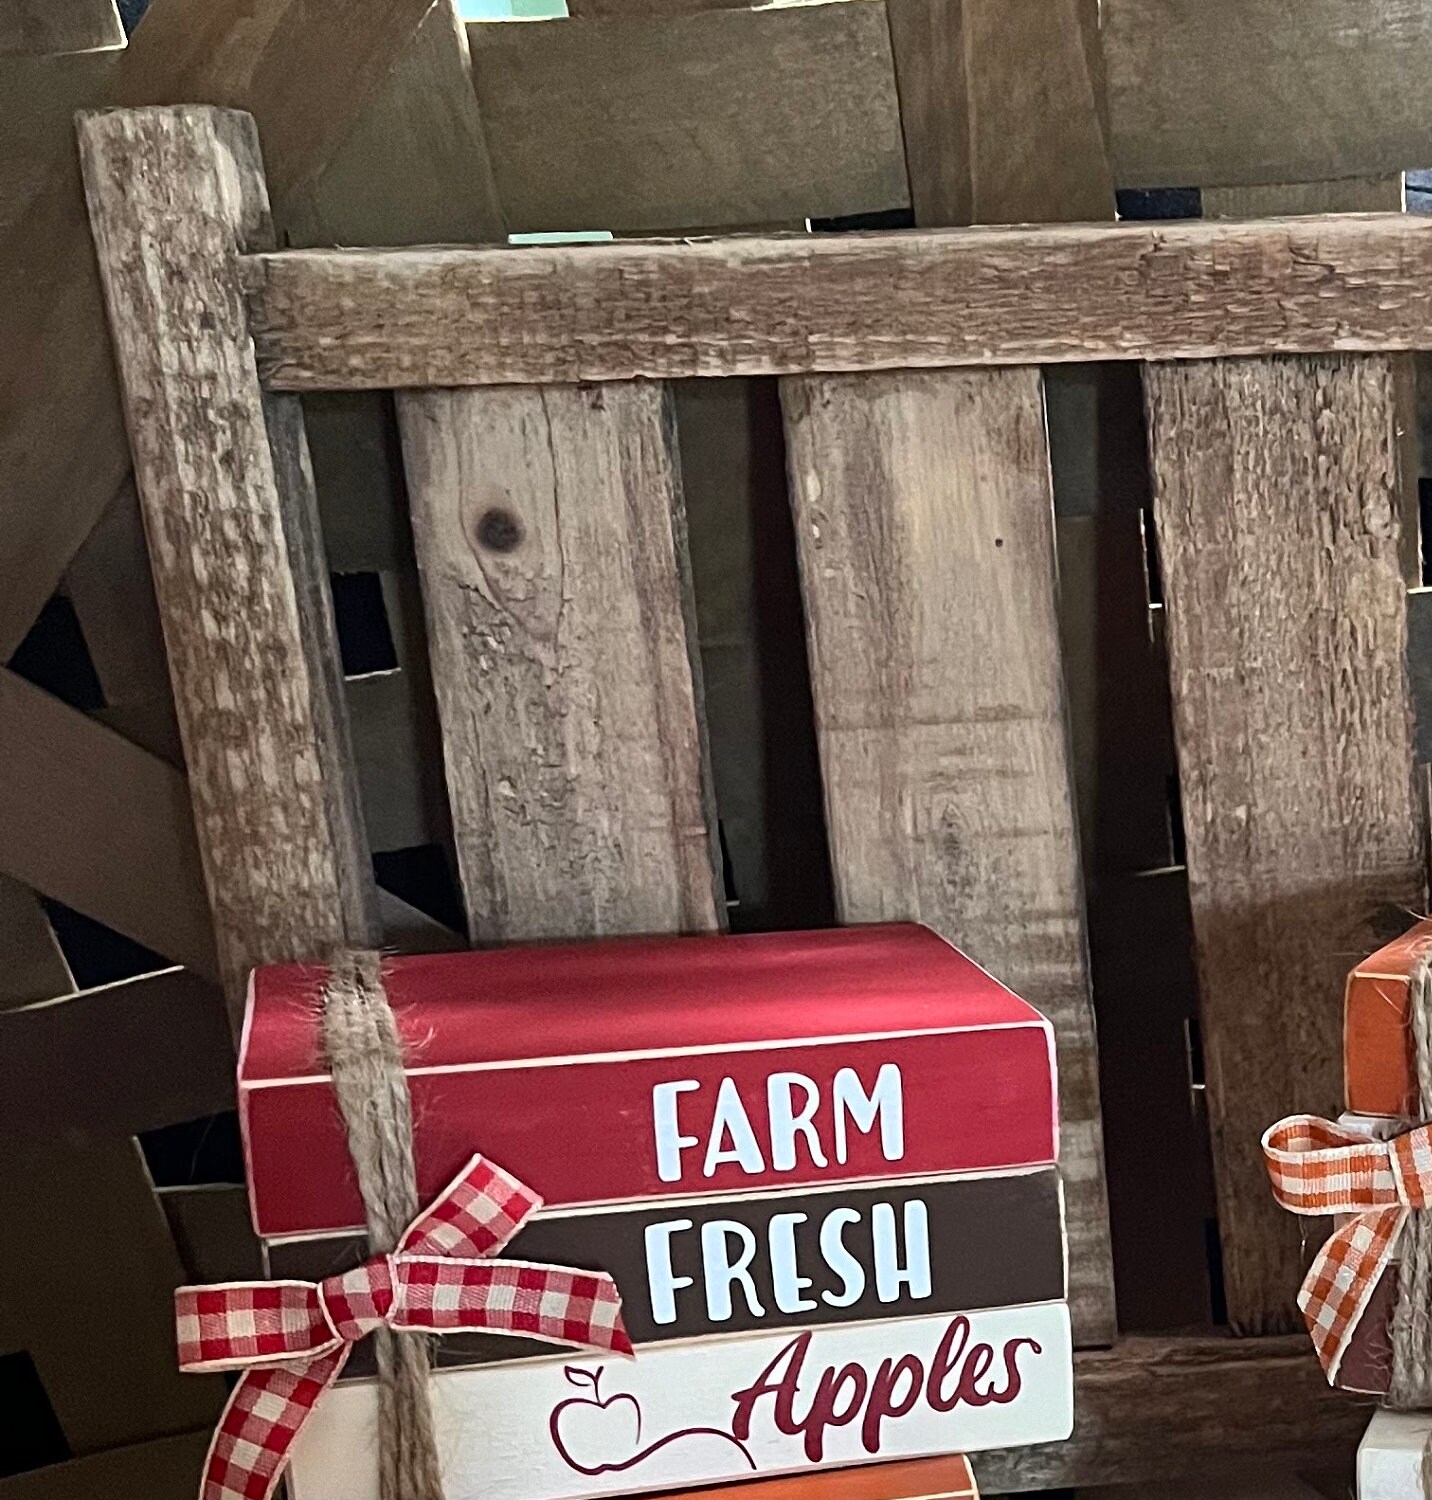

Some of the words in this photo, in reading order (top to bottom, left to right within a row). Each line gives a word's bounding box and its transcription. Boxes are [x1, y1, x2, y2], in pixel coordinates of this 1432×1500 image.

[652, 1062, 905, 1183] FARM
[643, 1199, 933, 1325] FRESH
[731, 1314, 1043, 1463] Apples
